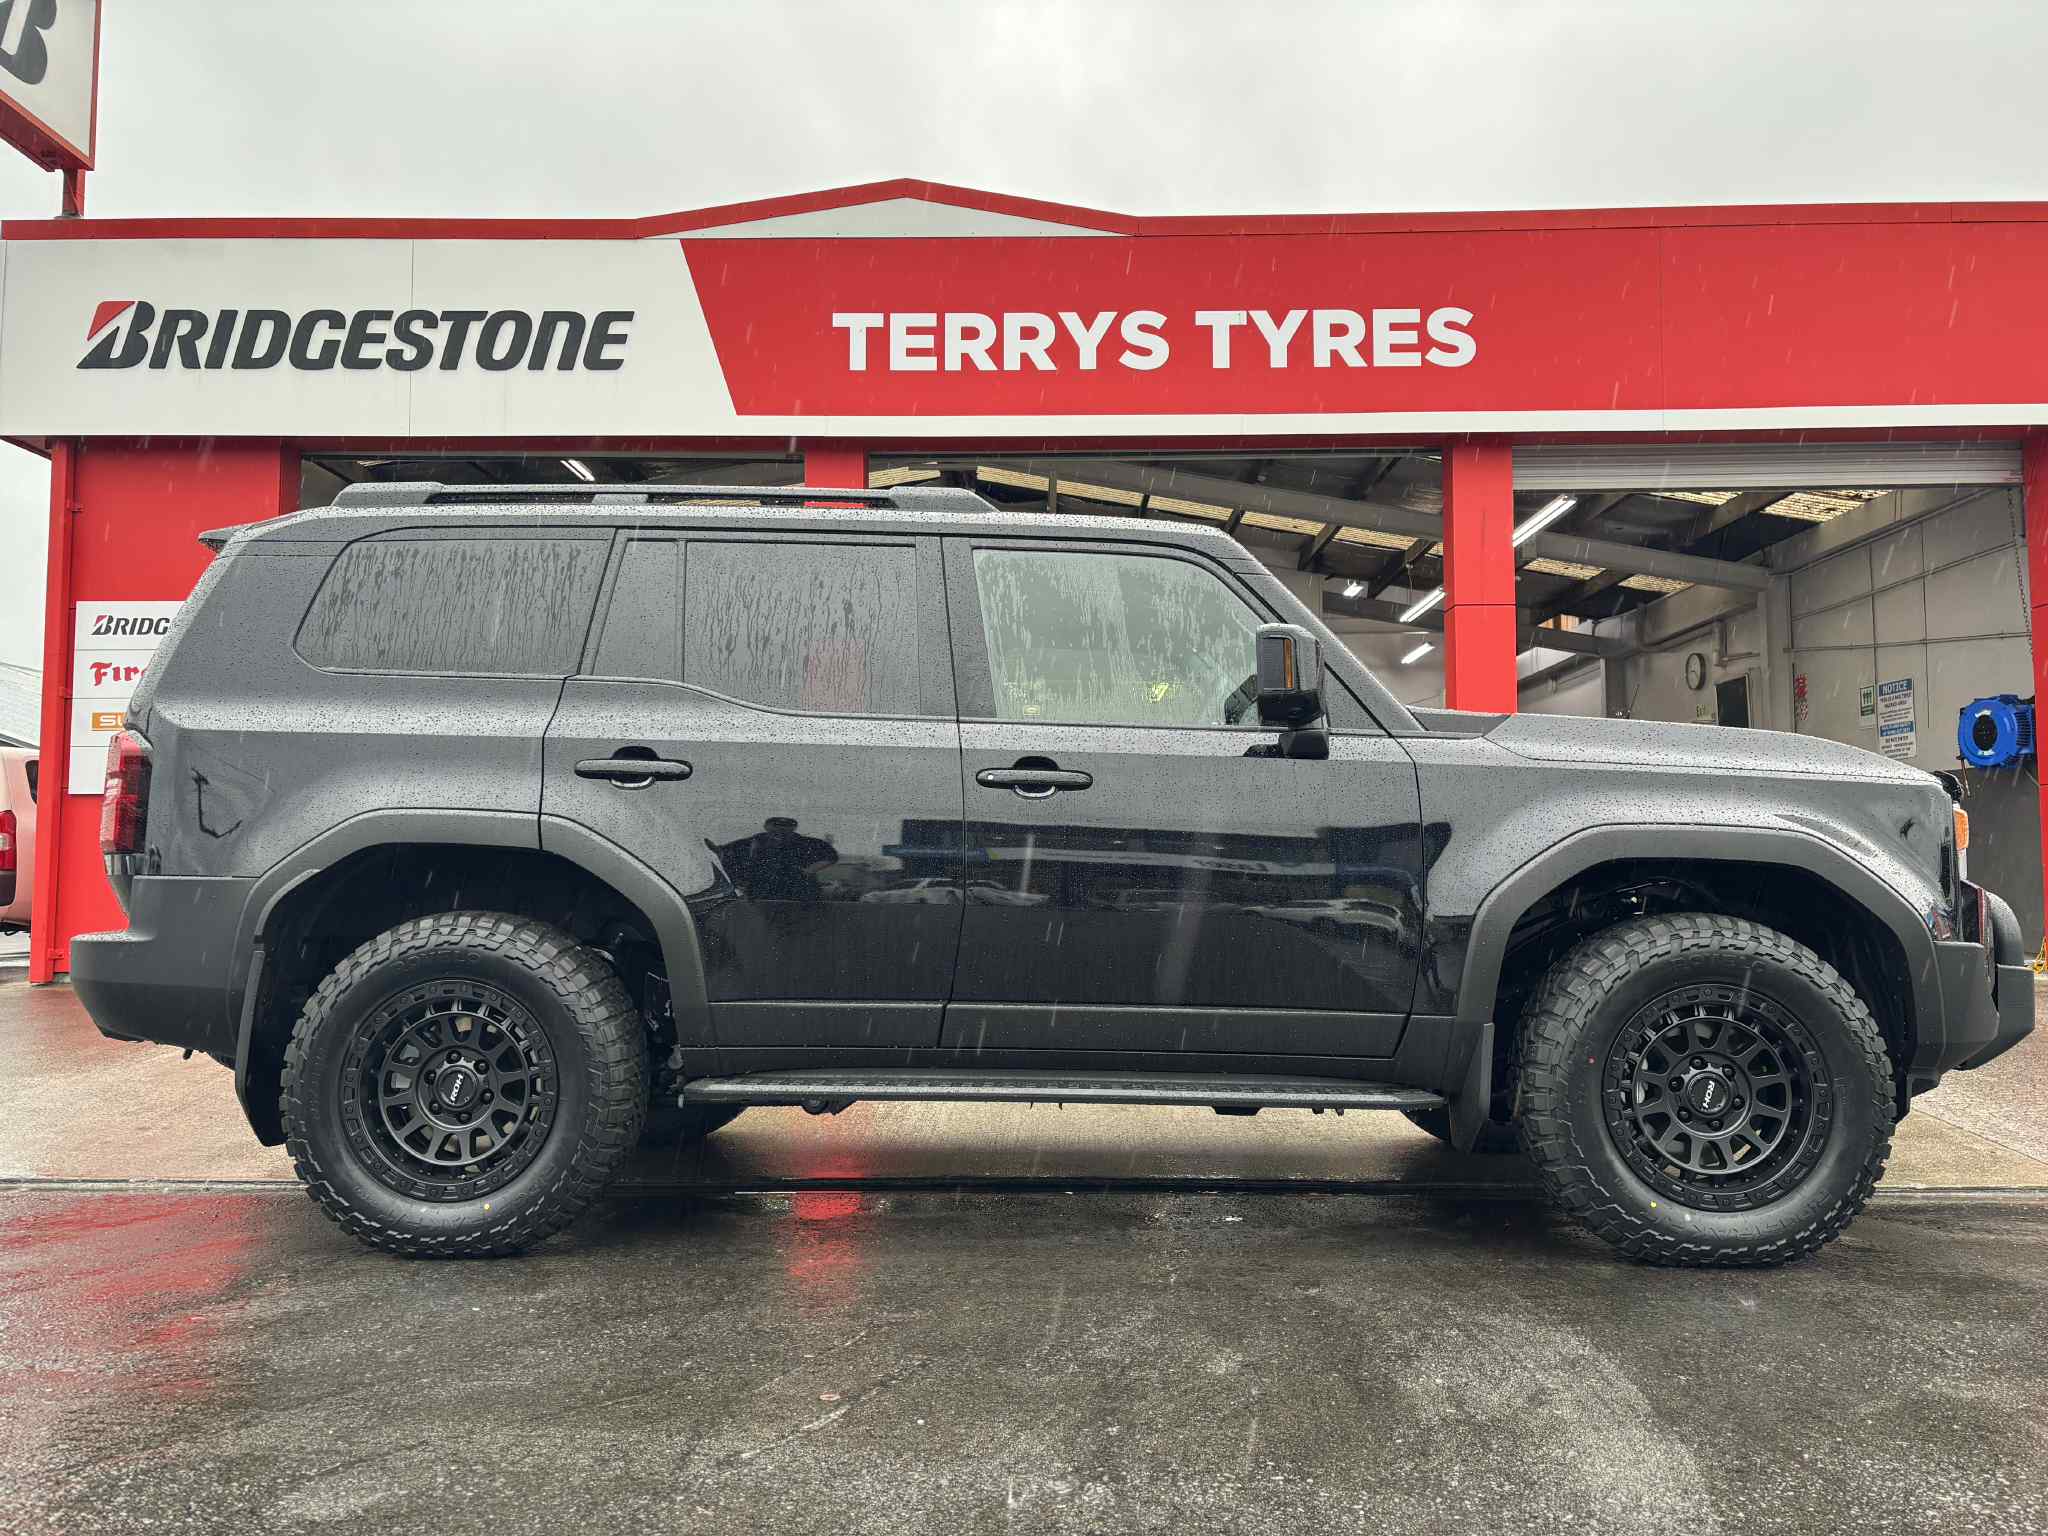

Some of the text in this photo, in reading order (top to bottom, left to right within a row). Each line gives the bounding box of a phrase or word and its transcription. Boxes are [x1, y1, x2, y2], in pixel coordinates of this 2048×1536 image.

[76, 300, 634, 371] BRIDGESTONE
[832, 307, 1477, 371] TERRYS TYRES
[90, 661, 145, 686] Fir
[1882, 680, 1909, 695] NOTICE
